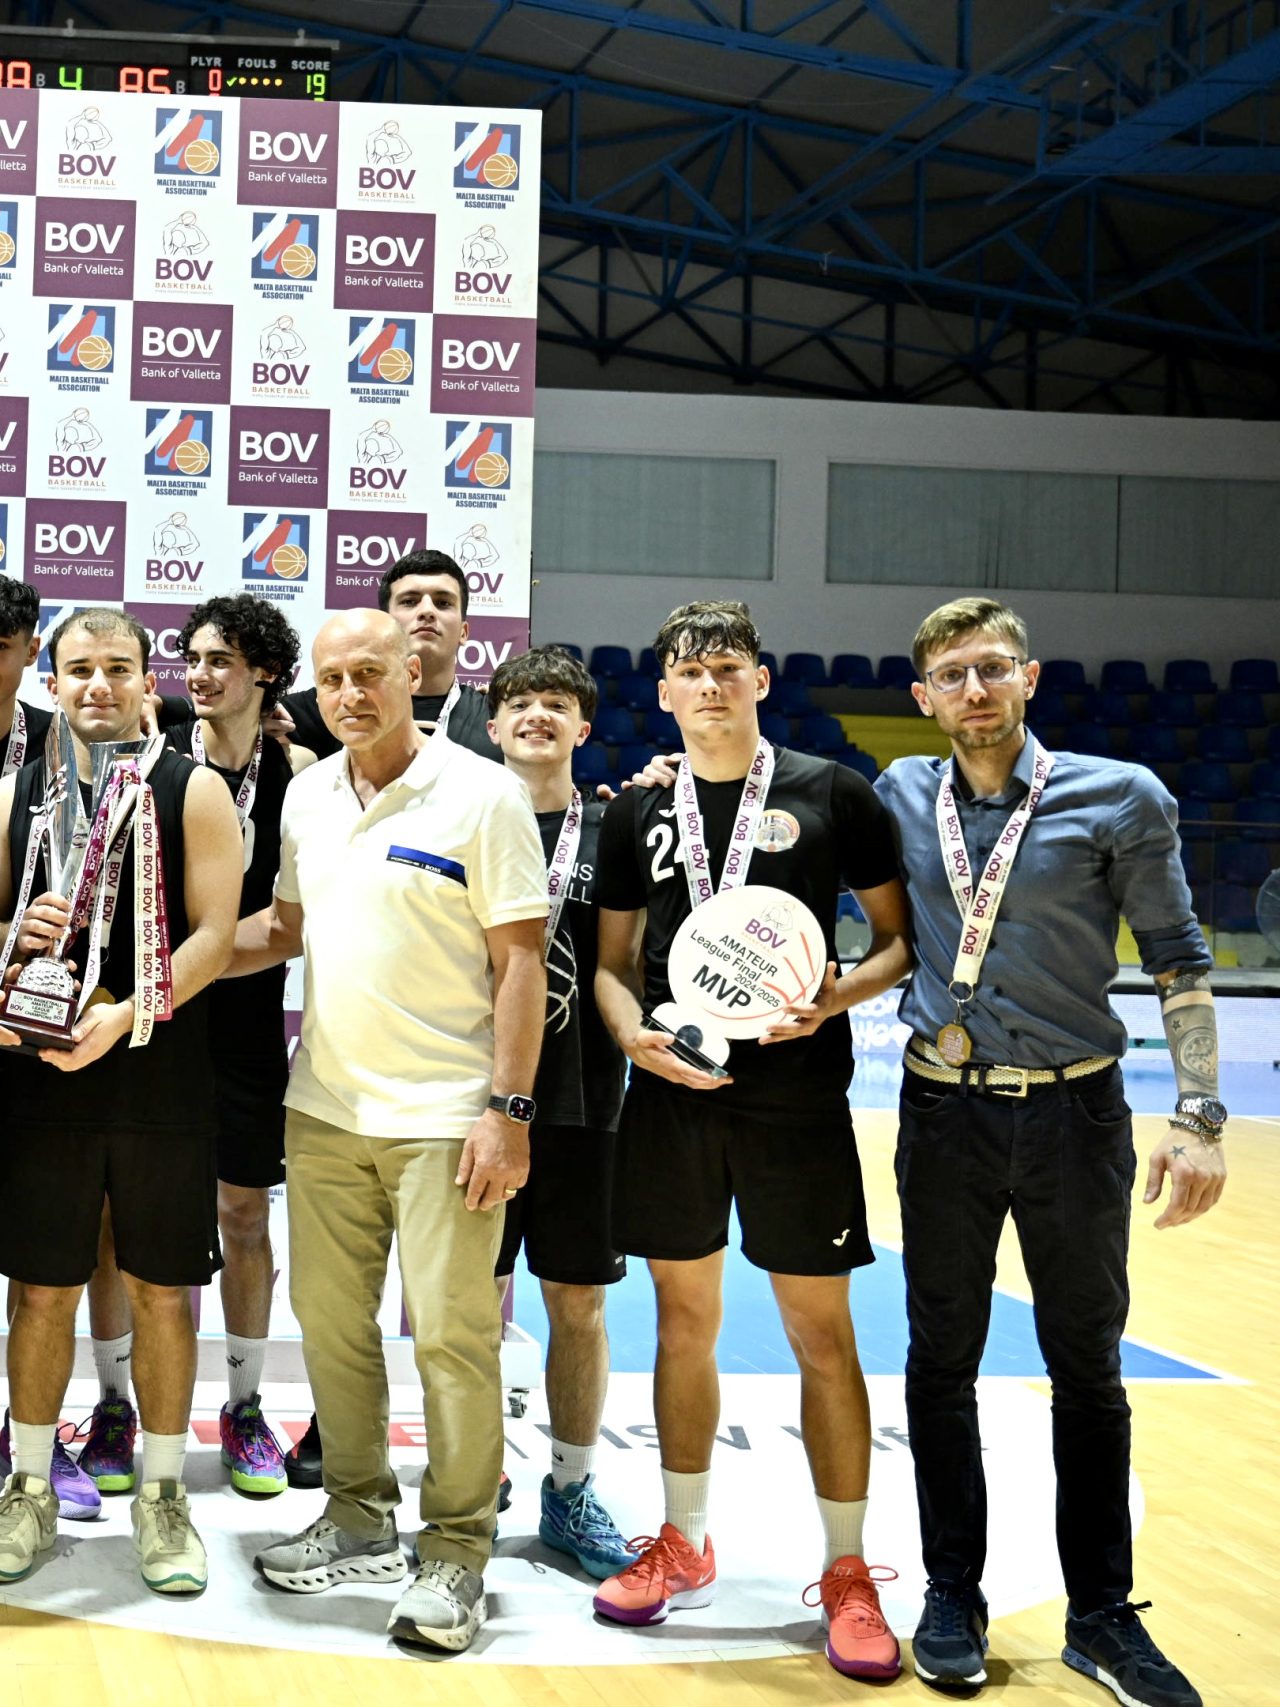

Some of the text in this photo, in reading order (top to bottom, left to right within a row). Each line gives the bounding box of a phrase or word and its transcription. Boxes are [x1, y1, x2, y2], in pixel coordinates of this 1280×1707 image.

[191, 56, 331, 71] PLYR FOULS SCORE
[36, 73, 46, 87] B
[59, 66, 82, 91] 4
[209, 69, 326, 96] 0 19
[249, 130, 328, 163] BOV
[58, 153, 116, 177] BOV
[248, 171, 327, 184] Bank of Valletta
[58, 178, 114, 186] BASKETBALL
[359, 167, 416, 190] BOV
[358, 191, 414, 199] BASKETBALL
[456, 192, 514, 202] MALTA BASKETBALL
[464, 201, 506, 209] ASSOCIATION
[345, 235, 424, 267] BOV
[345, 275, 423, 288] Bank of Valletta
[142, 326, 222, 358] BOV
[141, 367, 221, 380] Bank of Valletta
[358, 395, 400, 404] ASSOCIATION
[371, 388, 409, 396] BASKETBALL
[455, 500, 497, 508] ASSOCIATION
[468, 492, 506, 501] BASKETBALL
[35, 523, 115, 555] BOV
[34, 564, 114, 577] Bank of Valletta
[146, 559, 203, 582] BOV
[145, 583, 201, 591] BASKETBALL
[265, 584, 303, 593] BASKETBALL
[13, 742, 24, 767] BOV
[752, 751, 766, 775] BOV
[1035, 755, 1046, 780] BOV
[236, 785, 251, 808] BOV
[564, 811, 578, 834] BOV
[687, 812, 700, 837] BOV
[735, 815, 750, 840] BOV
[947, 815, 960, 842] BOV
[1001, 818, 1023, 845] BOV
[142, 822, 153, 849] BOV
[555, 839, 570, 864] BOV
[691, 844, 706, 870] BOV
[726, 848, 742, 875] BOV
[953, 849, 969, 877] BOV
[107, 862, 120, 888] BOV
[143, 855, 153, 881] BOV
[424, 864, 441, 874] BOSS
[985, 852, 1003, 882] BOV
[548, 870, 561, 896] BOV
[102, 896, 115, 923] BOV
[143, 888, 152, 913] BOV
[972, 888, 991, 918] BOV
[143, 921, 152, 946] BOV
[745, 918, 787, 950] BOV
[962, 925, 979, 955] BOV
[143, 953, 152, 979] BOV
[690, 929, 731, 962] League
[732, 958, 762, 982] Final
[719, 934, 778, 978] AMATEUR
[143, 986, 152, 1012] BOV
[691, 964, 752, 1009] MVP
[734, 973, 781, 1008] 2024/2025
[9, 1003, 24, 1011] BOV
[139, 1019, 151, 1043] BOV
